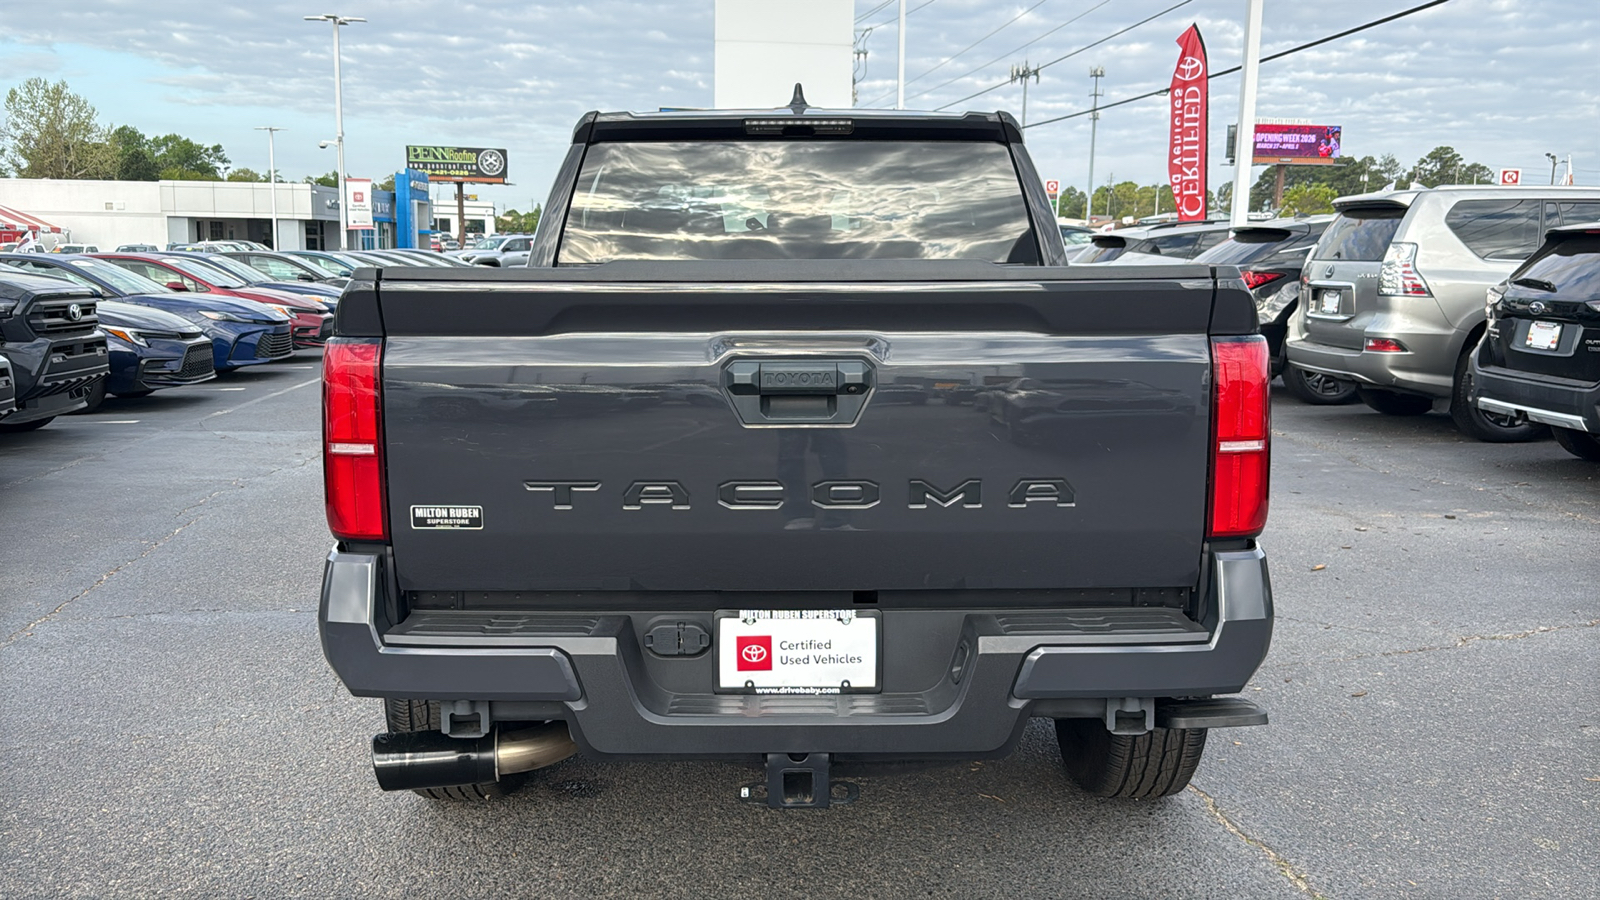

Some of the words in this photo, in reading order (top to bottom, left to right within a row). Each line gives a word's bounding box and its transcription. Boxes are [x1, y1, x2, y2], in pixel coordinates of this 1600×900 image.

[1256, 133, 1283, 142] OPENING
[1283, 133, 1301, 143] WEEK
[1301, 134, 1316, 143] 2026
[408, 146, 453, 160] PENN
[450, 149, 477, 163] Roofing
[764, 373, 833, 386] TOYOTA
[523, 479, 1076, 510] TACOMA
[415, 508, 448, 518] MILTON
[449, 508, 479, 518] RUBEN
[739, 610, 772, 619] MILTON
[772, 610, 800, 619] RUBEN
[801, 610, 857, 619] SUPERSTORE
[779, 639, 832, 651] Certified
[780, 655, 810, 665] Used
[813, 654, 862, 664] Vehicles
[755, 687, 840, 696] www.drivebaby.com
